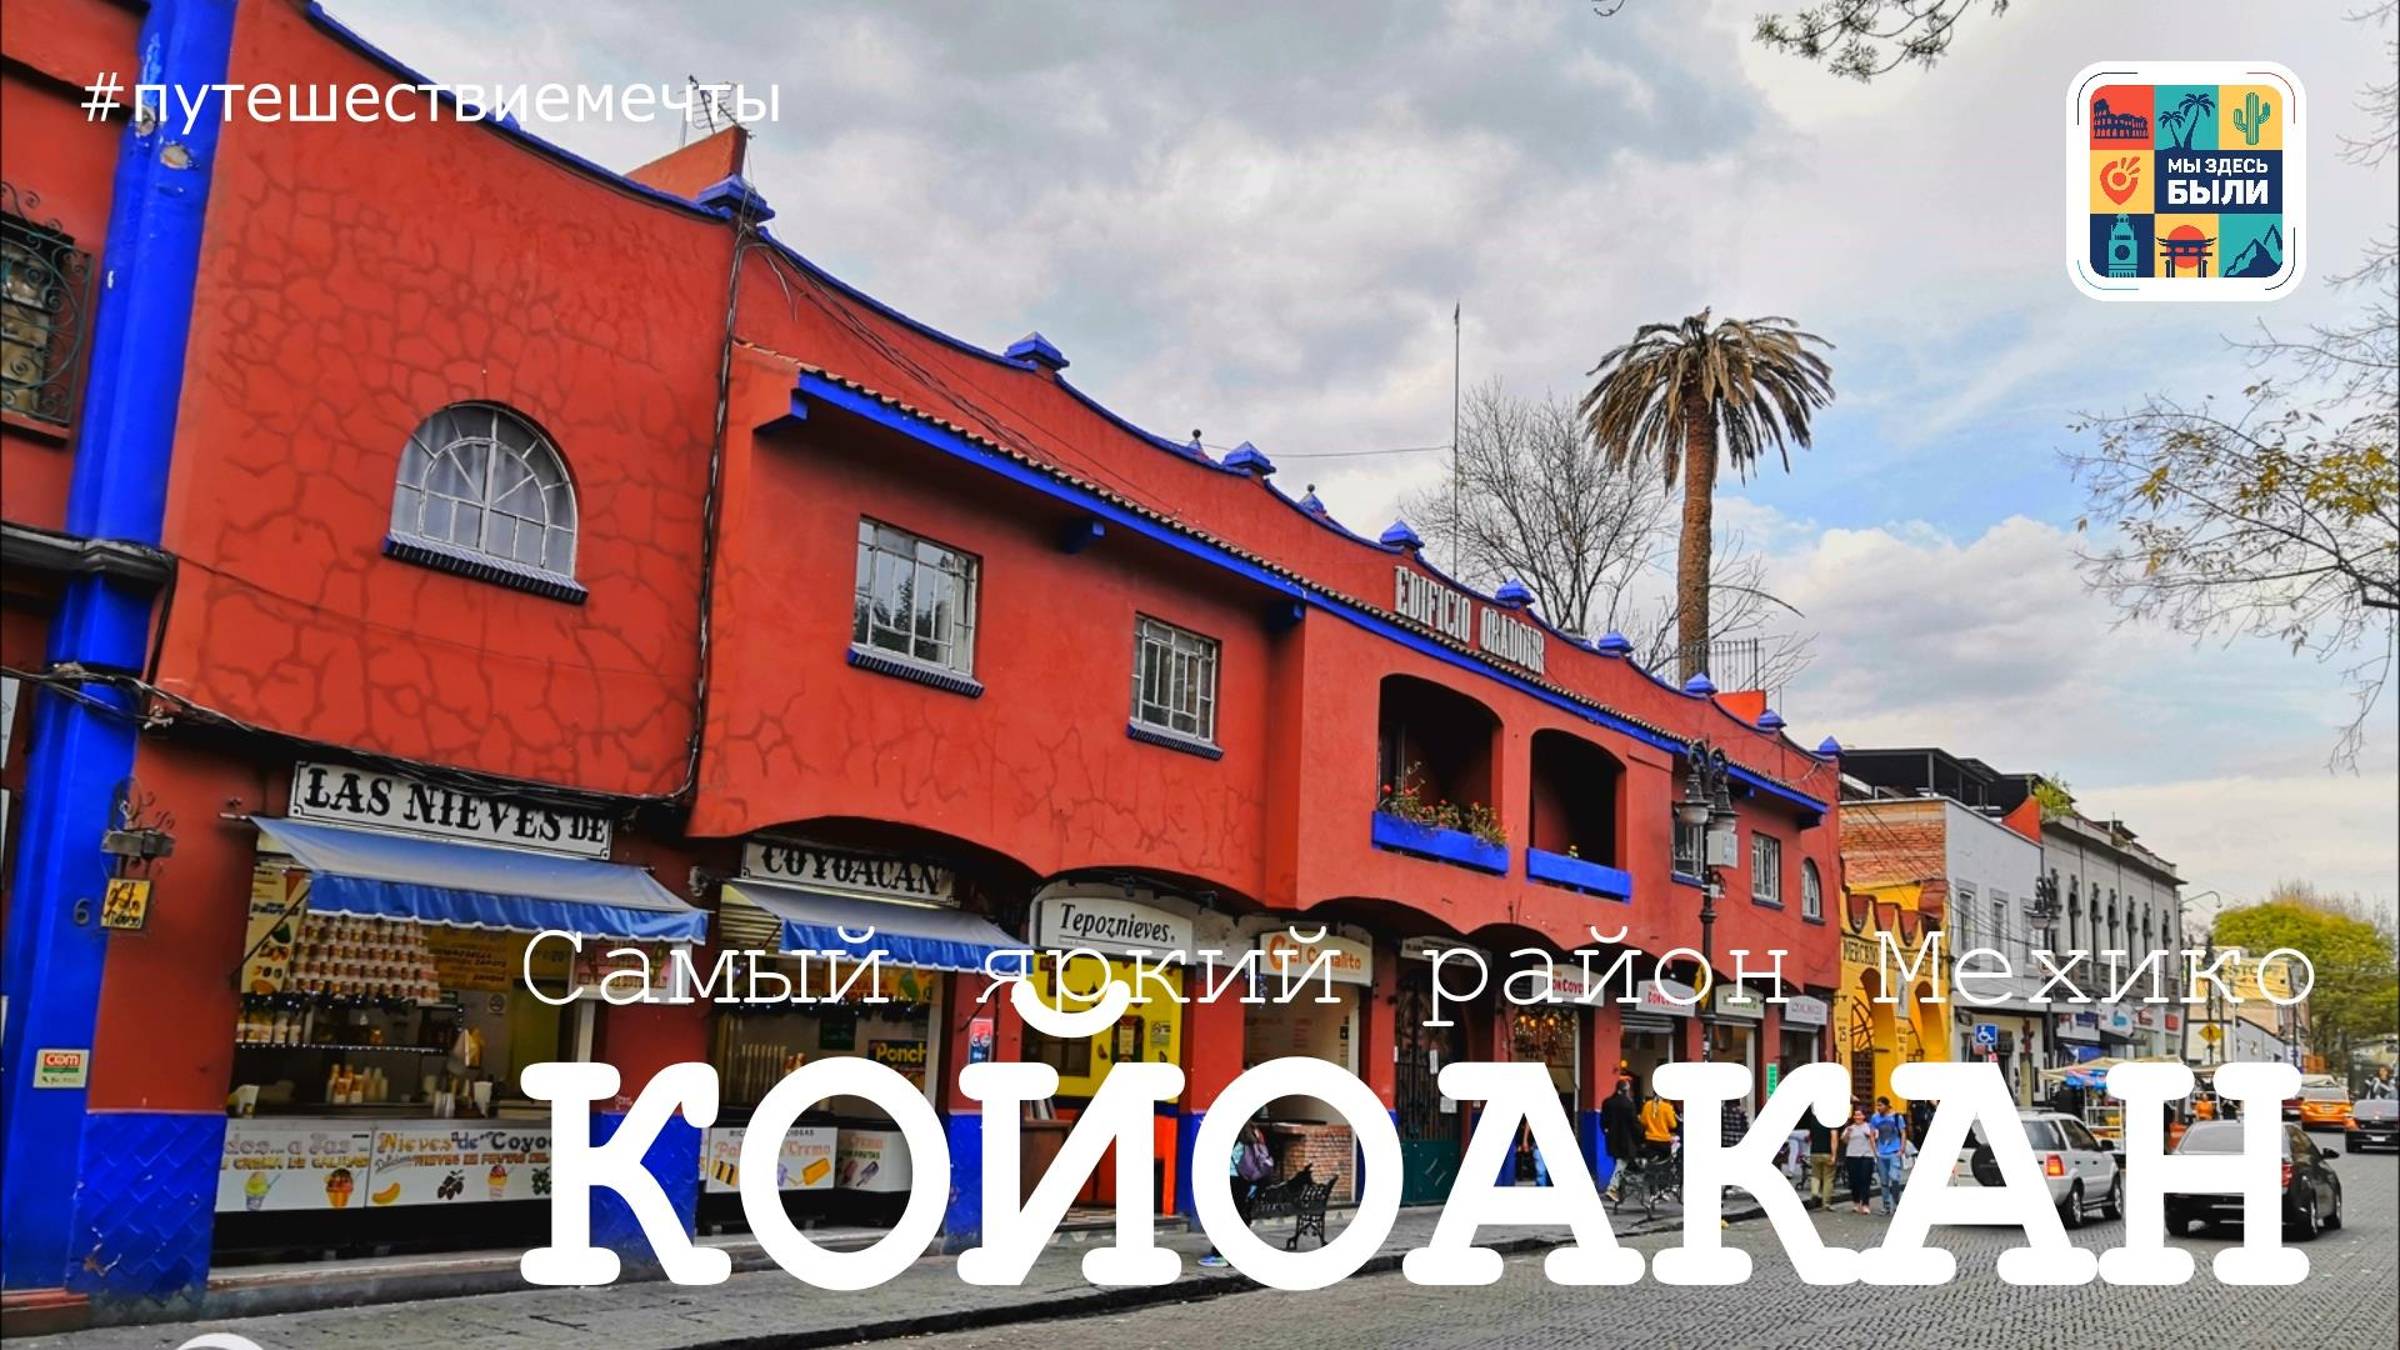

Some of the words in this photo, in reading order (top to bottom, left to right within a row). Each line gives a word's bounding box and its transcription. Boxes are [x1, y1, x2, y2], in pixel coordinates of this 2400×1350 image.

[1394, 565, 1471, 644] EDIFICIO
[304, 767, 393, 816] LAS
[402, 782, 561, 842] NIEVES
[568, 812, 606, 843] DE
[761, 844, 941, 895] COYOACAN
[74, 898, 89, 925] 6
[377, 1132, 451, 1154] Nieves
[491, 1131, 552, 1153] Coyo
